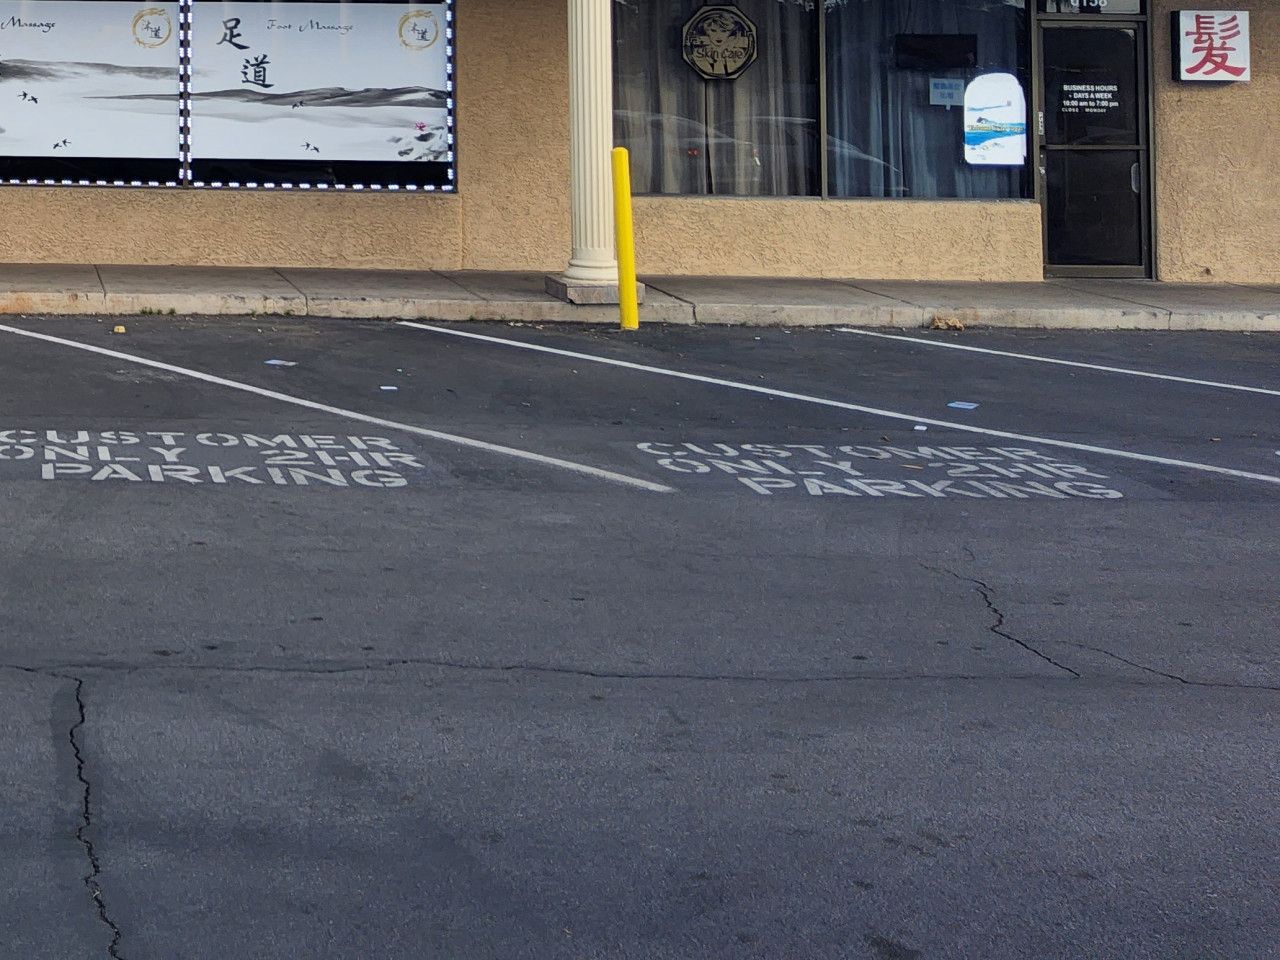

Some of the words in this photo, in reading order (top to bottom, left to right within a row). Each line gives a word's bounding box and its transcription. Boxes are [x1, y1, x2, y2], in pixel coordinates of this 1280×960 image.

[0, 15, 56, 33] Massage
[266, 19, 292, 31] Foot
[299, 19, 354, 35] Massage
[1185, 14, 1247, 77] 髮
[1063, 84, 1095, 92] BUSINESS
[264, 449, 426, 469] 2HR
[635, 442, 1060, 461] CUSTOMER
[40, 461, 409, 488] PARKING
[655, 457, 866, 477] ONLY
[928, 461, 1113, 480] 2HR
[736, 476, 1125, 499] PARKING
